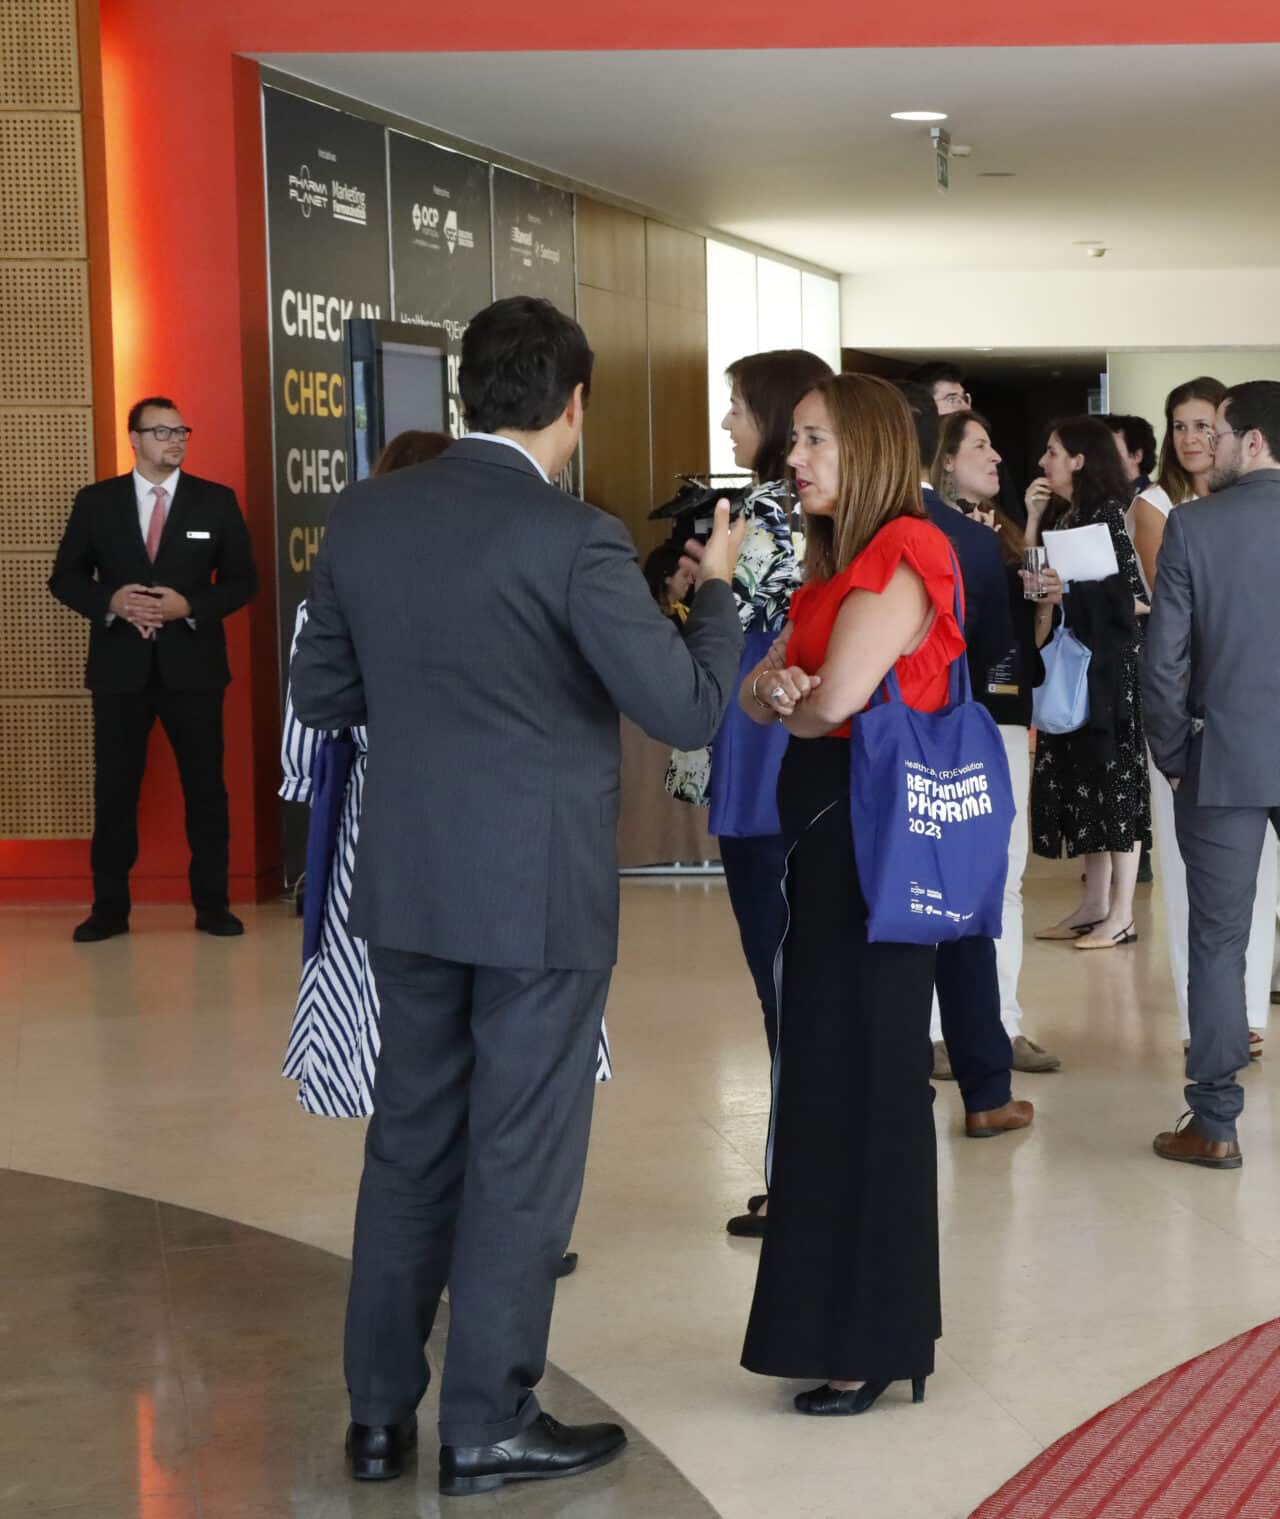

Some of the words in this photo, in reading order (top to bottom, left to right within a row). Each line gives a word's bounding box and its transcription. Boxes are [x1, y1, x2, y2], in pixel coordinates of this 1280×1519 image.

[284, 368, 346, 418] CHEC
[287, 447, 349, 494] CHEC
[907, 791, 993, 823] PHARMA
[908, 816, 943, 840] 2023
